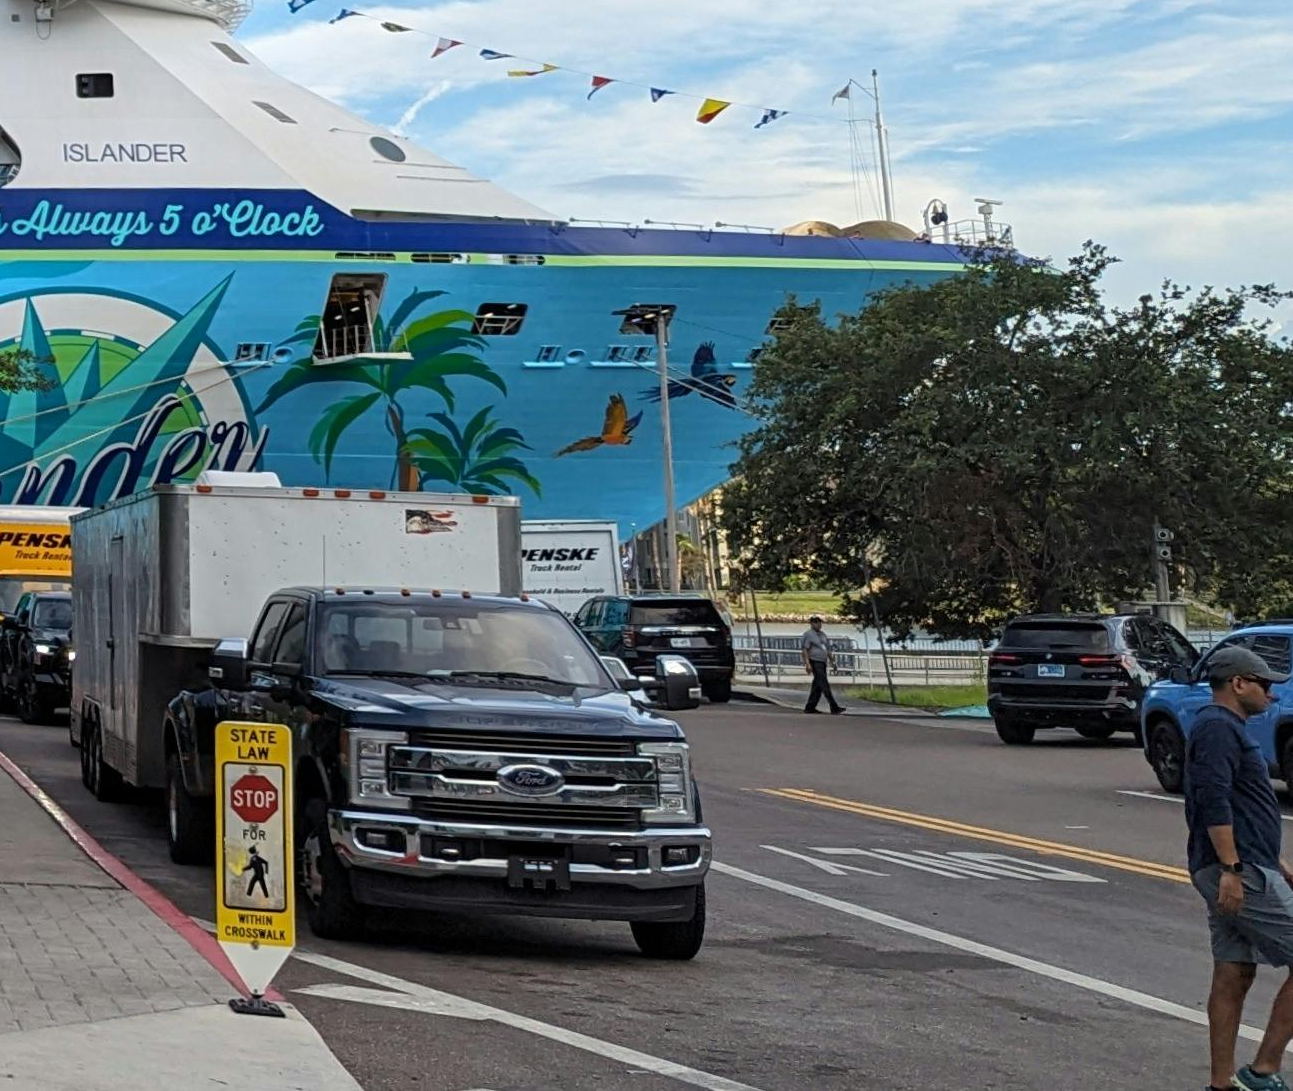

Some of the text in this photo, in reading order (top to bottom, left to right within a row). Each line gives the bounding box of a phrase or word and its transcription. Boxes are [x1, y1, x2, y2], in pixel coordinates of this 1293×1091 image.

[63, 144, 187, 163] ISLANDER
[11, 200, 152, 247] Always
[160, 206, 183, 236] 5
[191, 199, 324, 238] o'Clock
[15, 550, 40, 559] Truck
[531, 564, 552, 572] Truck
[230, 728, 277, 745] STATE
[237, 746, 269, 760] LAW
[515, 771, 548, 786] Ford
[233, 789, 276, 809] STOP
[242, 829, 266, 841] FOR
[237, 913, 273, 926] WITHIN
[224, 925, 286, 941] CROSSWALK
